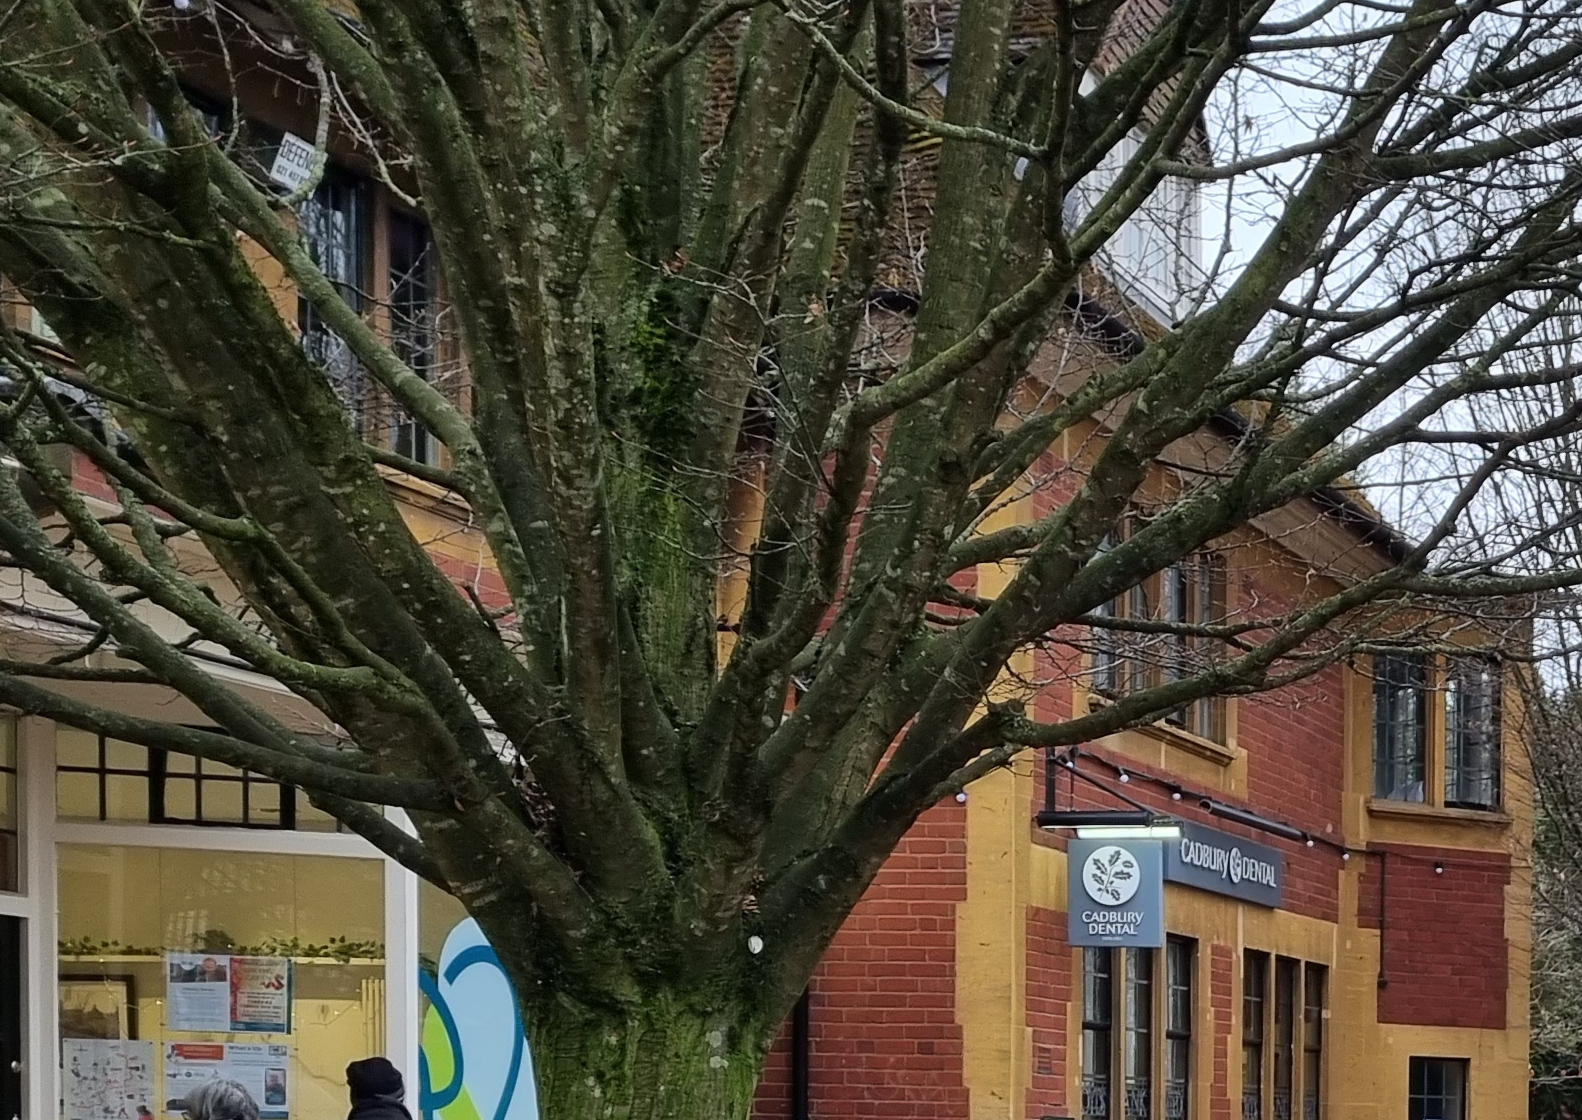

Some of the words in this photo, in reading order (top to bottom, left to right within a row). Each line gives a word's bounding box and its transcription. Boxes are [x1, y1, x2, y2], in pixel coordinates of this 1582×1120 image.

[281, 140, 314, 172] DEFEN
[1180, 838, 1229, 879] CADBURY
[1242, 856, 1277, 888] DENTAL
[1082, 911, 1144, 926] CADBURY
[1088, 923, 1138, 935] DENTAL
